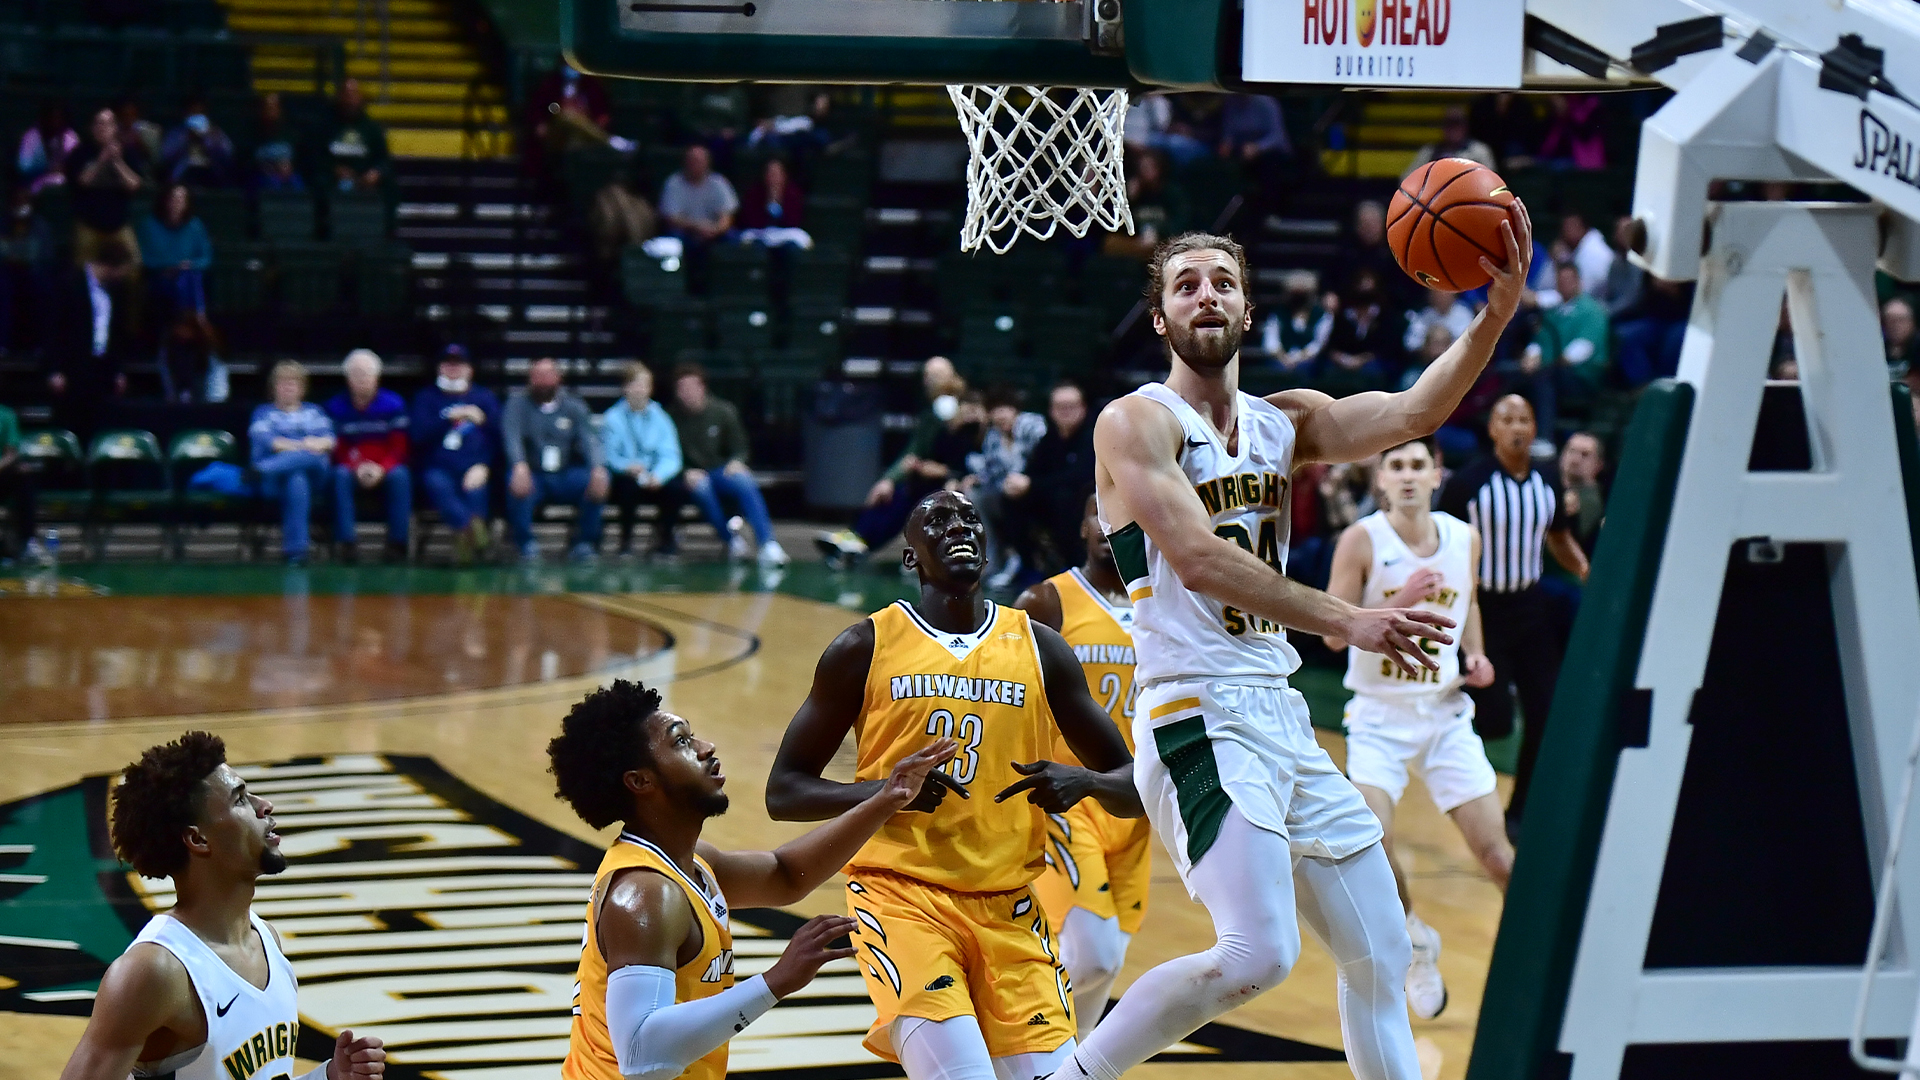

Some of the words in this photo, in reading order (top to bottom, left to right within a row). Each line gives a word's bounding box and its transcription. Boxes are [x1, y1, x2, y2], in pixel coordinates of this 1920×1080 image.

[1381, 0, 1451, 46] HEAD
[1335, 55, 1415, 78] BURRITOS
[890, 673, 1026, 708] MILWAUKEE
